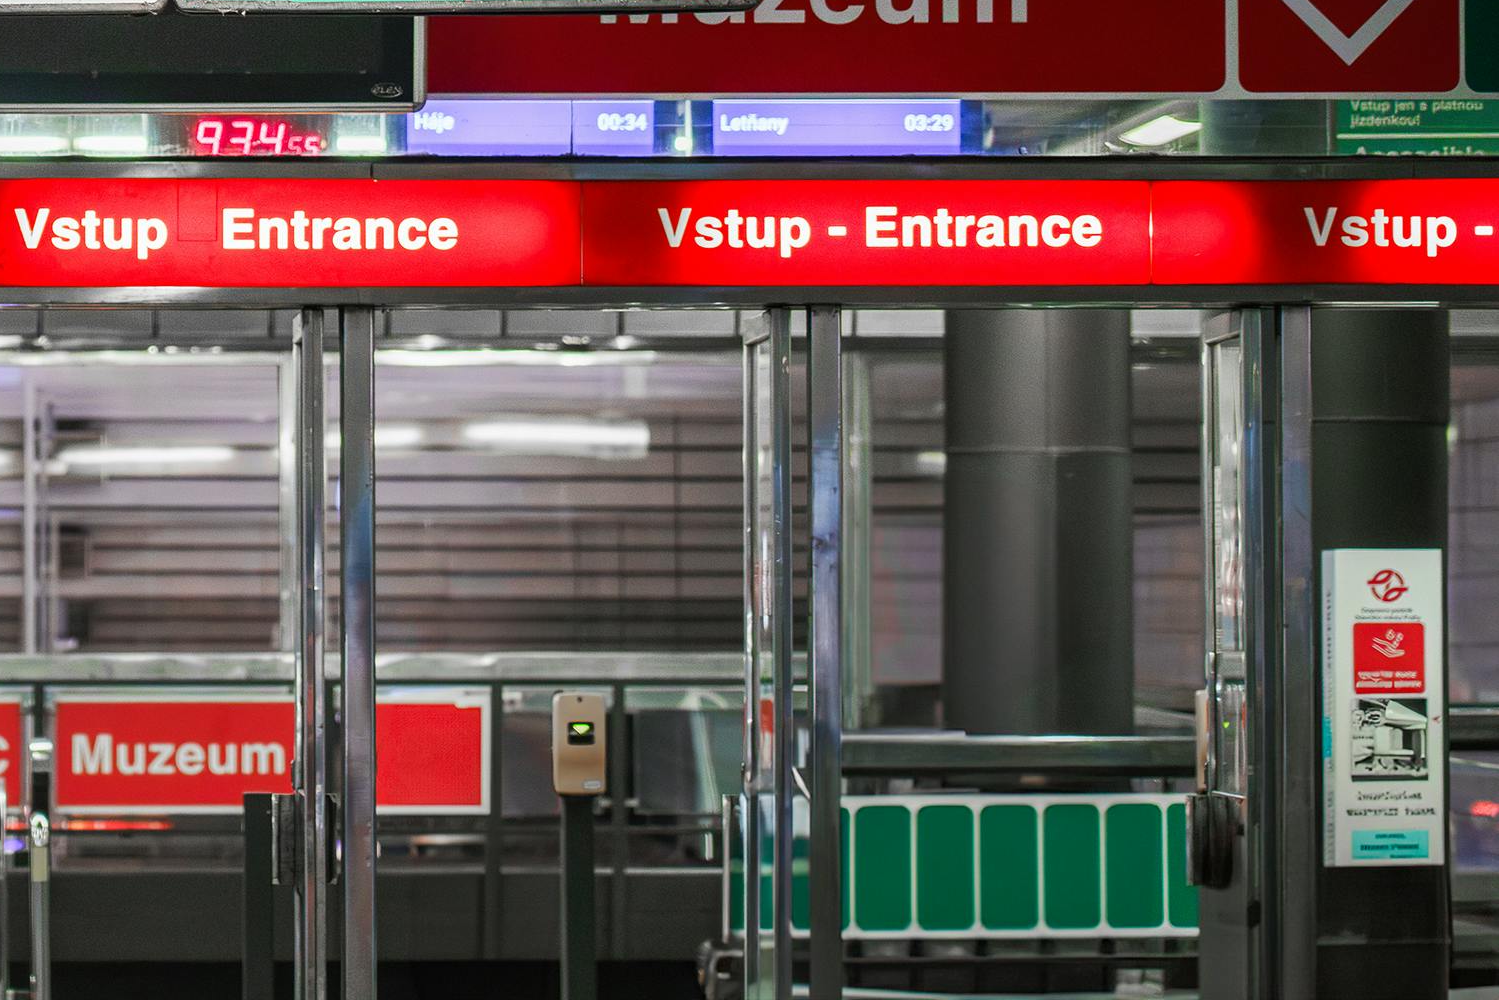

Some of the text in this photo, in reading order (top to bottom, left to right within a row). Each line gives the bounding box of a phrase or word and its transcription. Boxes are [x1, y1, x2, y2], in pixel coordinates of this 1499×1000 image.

[414, 112, 455, 134] Háje
[596, 112, 648, 132] 00:34
[720, 113, 789, 136] Letňany
[903, 113, 954, 132] 03:29
[14, 207, 169, 260] Vstup
[222, 207, 459, 251] Entrance
[658, 207, 812, 259] Vstup
[865, 206, 1103, 248] Entrance
[1303, 207, 1458, 258] Vstup
[71, 733, 286, 776] Muzeum
